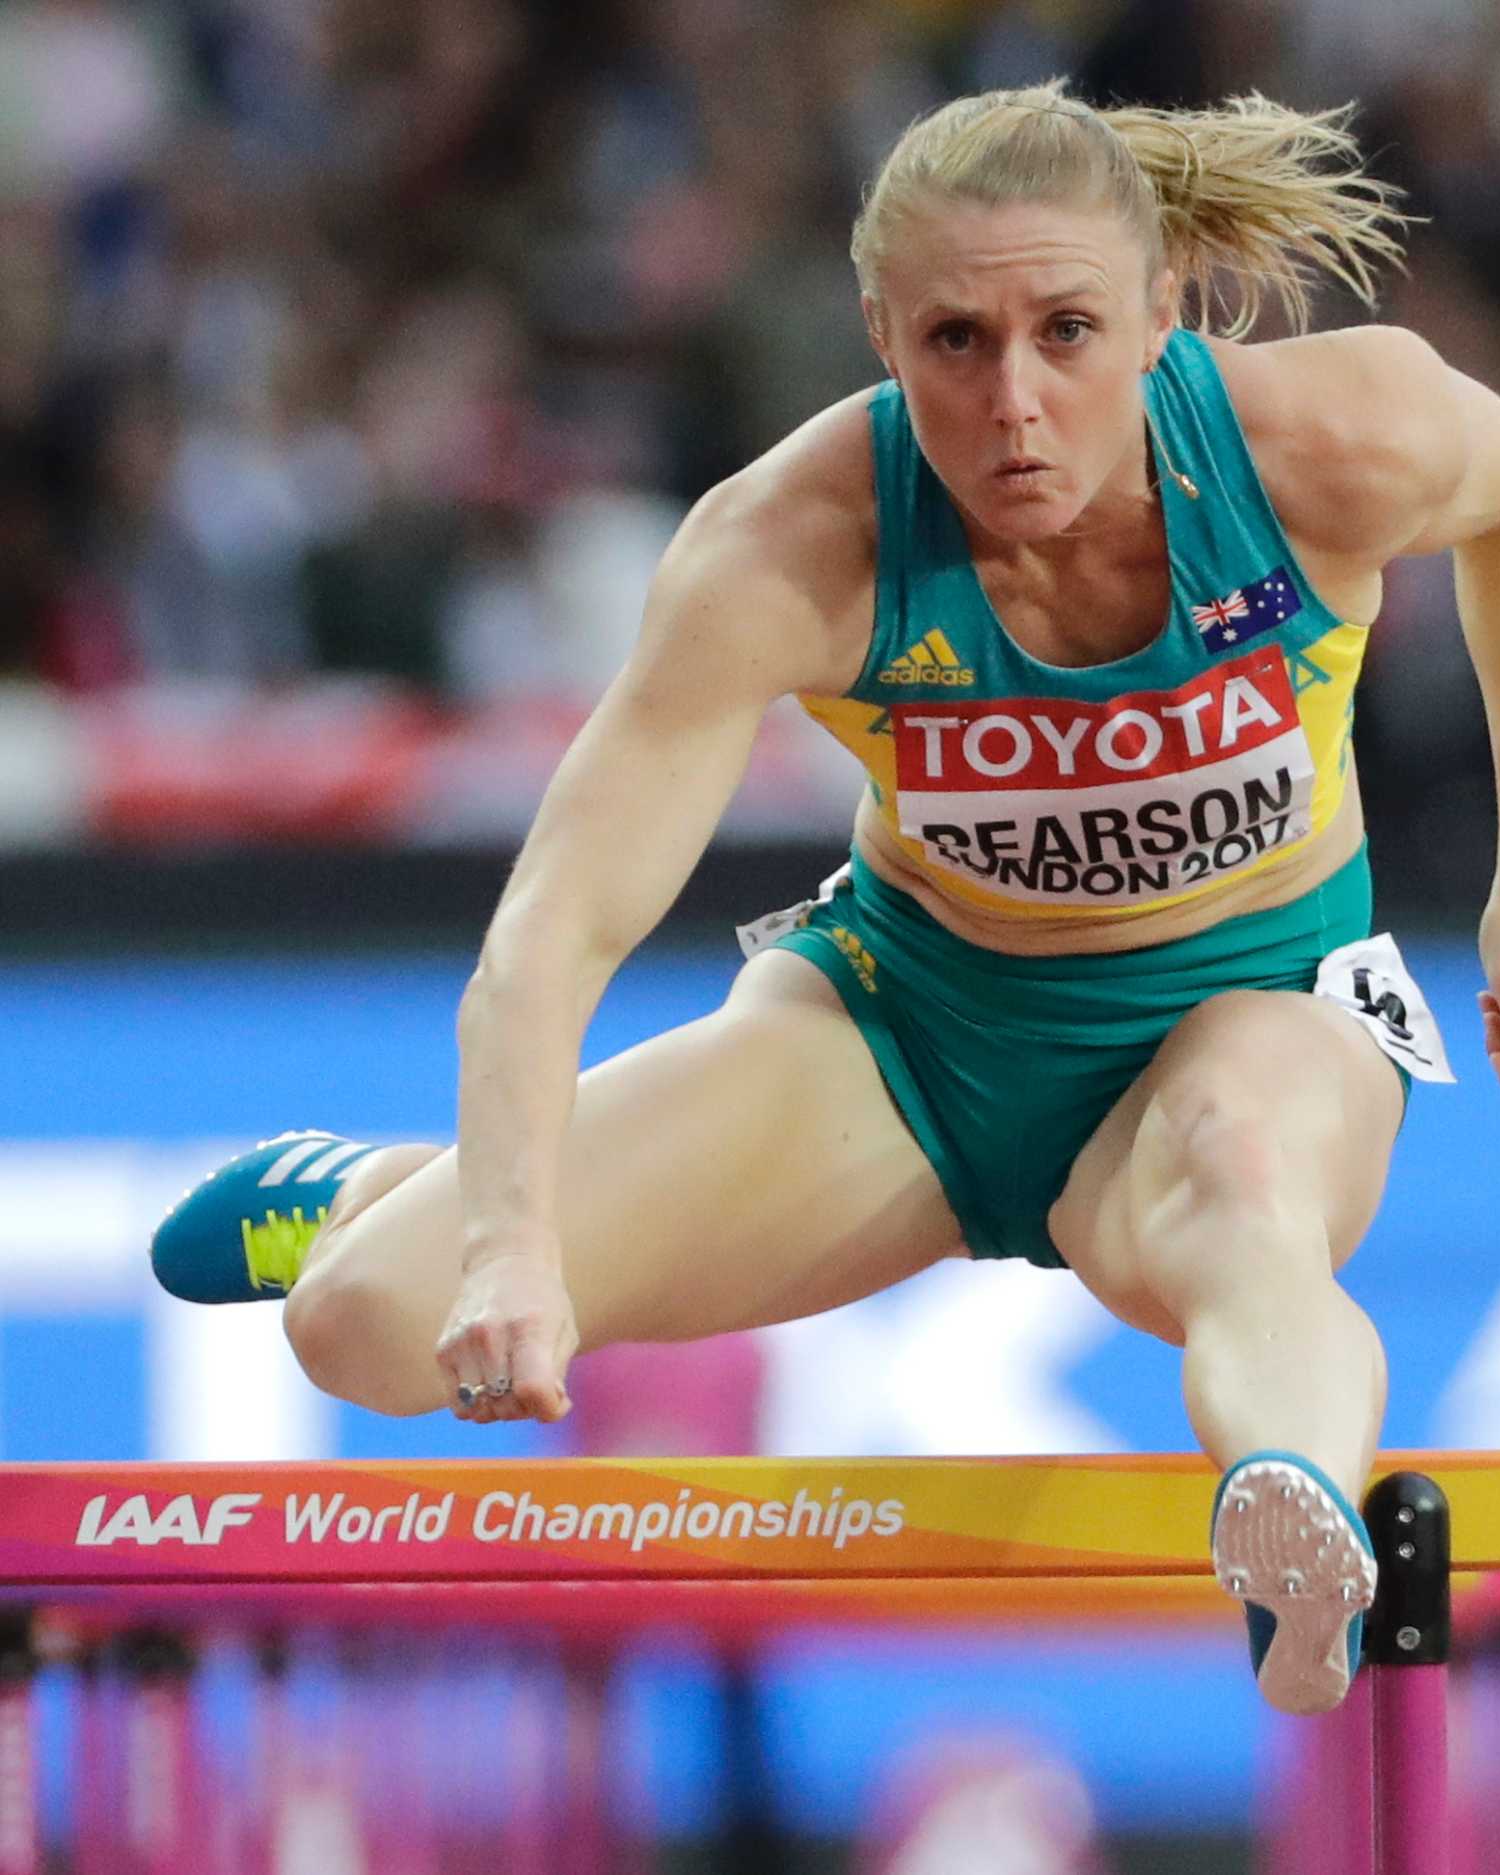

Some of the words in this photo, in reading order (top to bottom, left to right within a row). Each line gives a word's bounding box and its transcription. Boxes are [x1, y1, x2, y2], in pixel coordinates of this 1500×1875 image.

[878, 664, 976, 687] adidas
[903, 675, 1283, 778] TOYOTA
[922, 767, 1293, 863] PEARSON
[1181, 813, 1290, 885] 2017
[75, 1493, 263, 1546] IAAF
[284, 1492, 455, 1544] World
[471, 1486, 906, 1552] Championships
